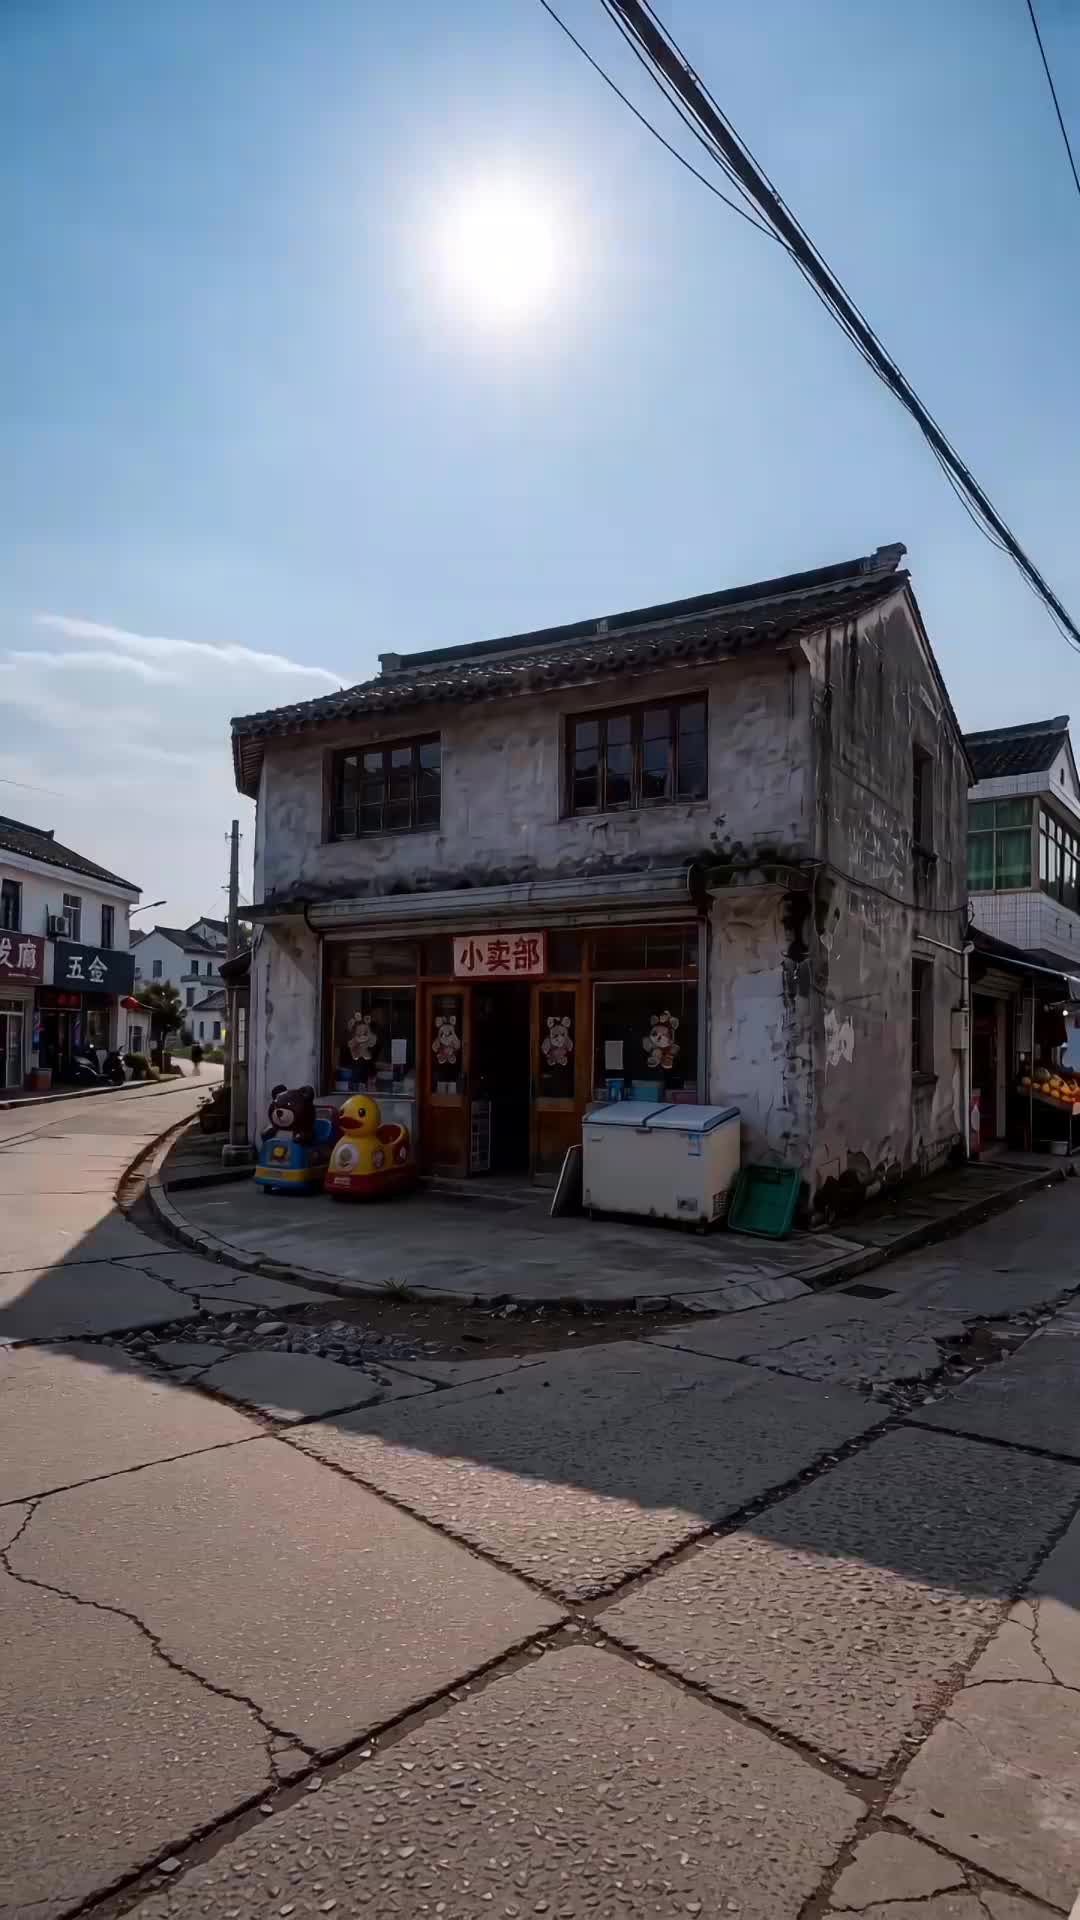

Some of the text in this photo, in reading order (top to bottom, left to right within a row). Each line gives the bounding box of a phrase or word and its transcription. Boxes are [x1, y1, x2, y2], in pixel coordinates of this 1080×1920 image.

[66, 955, 109, 983] 五金
[460, 937, 540, 972] 小卖部
